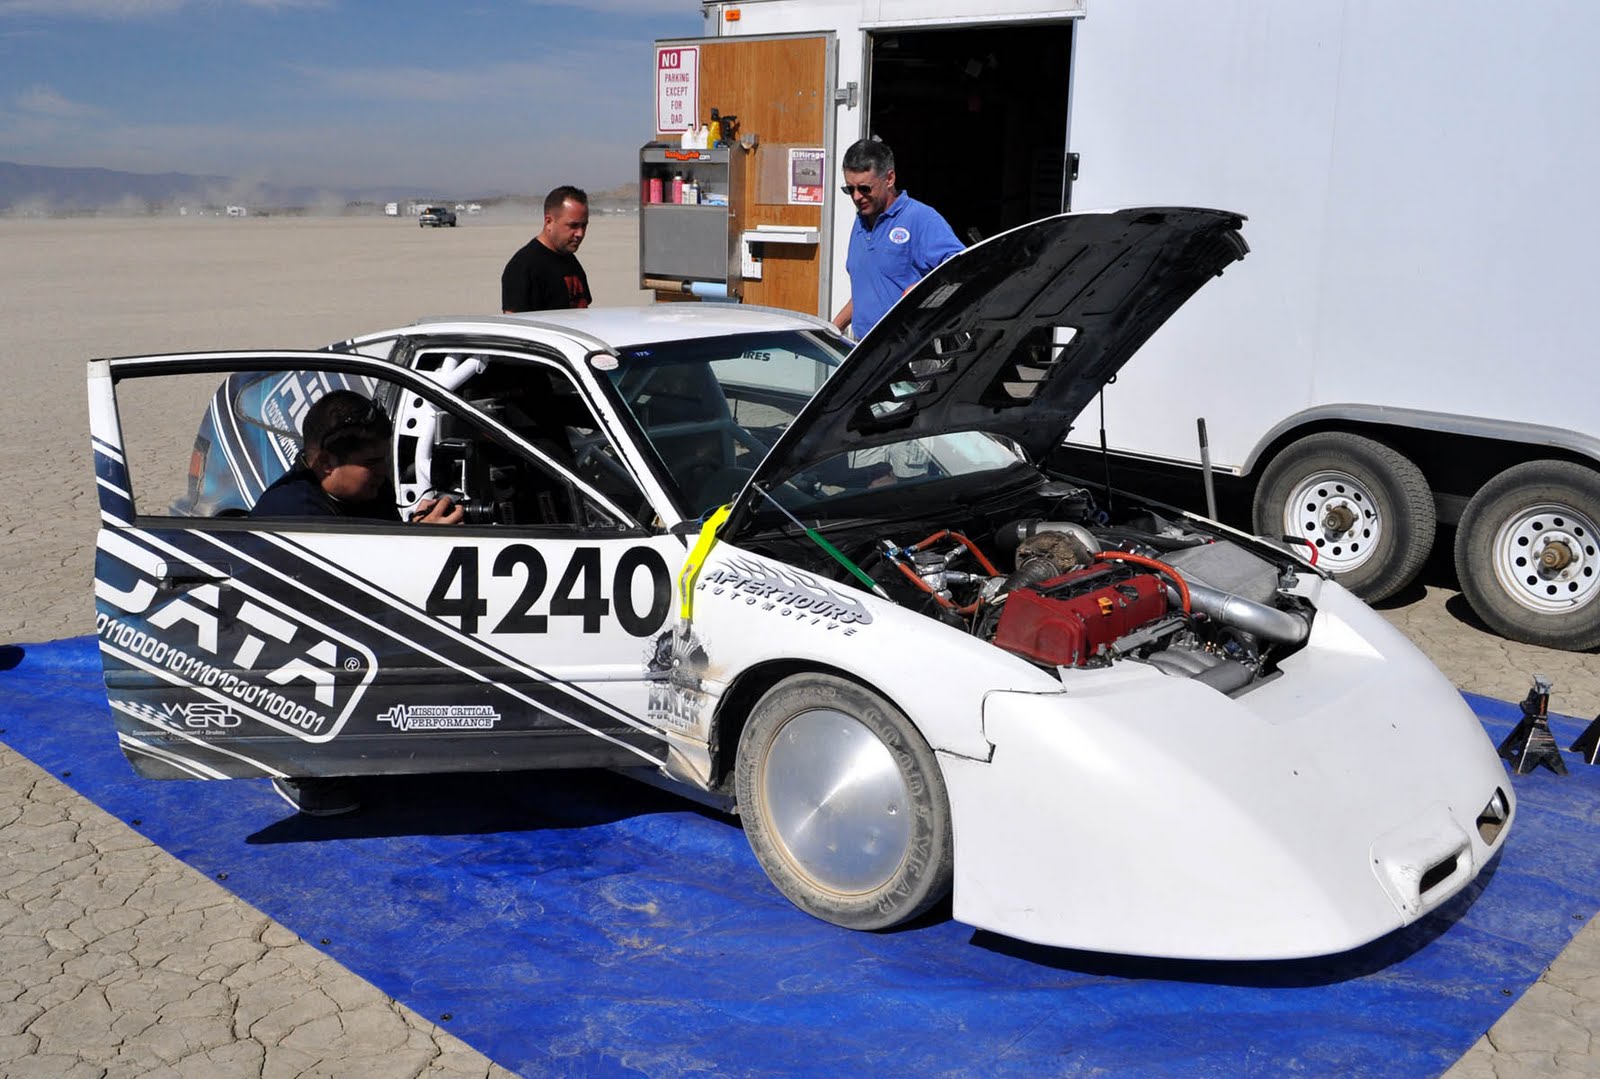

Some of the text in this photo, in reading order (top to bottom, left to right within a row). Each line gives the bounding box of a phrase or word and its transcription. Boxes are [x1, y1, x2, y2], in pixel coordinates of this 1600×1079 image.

[661, 52, 678, 68] NO
[664, 73, 690, 83] PARKING
[665, 86, 688, 97] EXCEPT
[670, 100, 683, 110] FOR
[670, 113, 683, 124] DAD
[743, 351, 771, 362] IRES
[425, 543, 672, 638] 4240
[696, 582, 858, 637] AUTOMOTIVE
[161, 702, 232, 717] WEST
[410, 707, 493, 716] MISSION CRITICAL
[185, 713, 242, 728] END
[411, 719, 492, 728] PERFORMANCE
